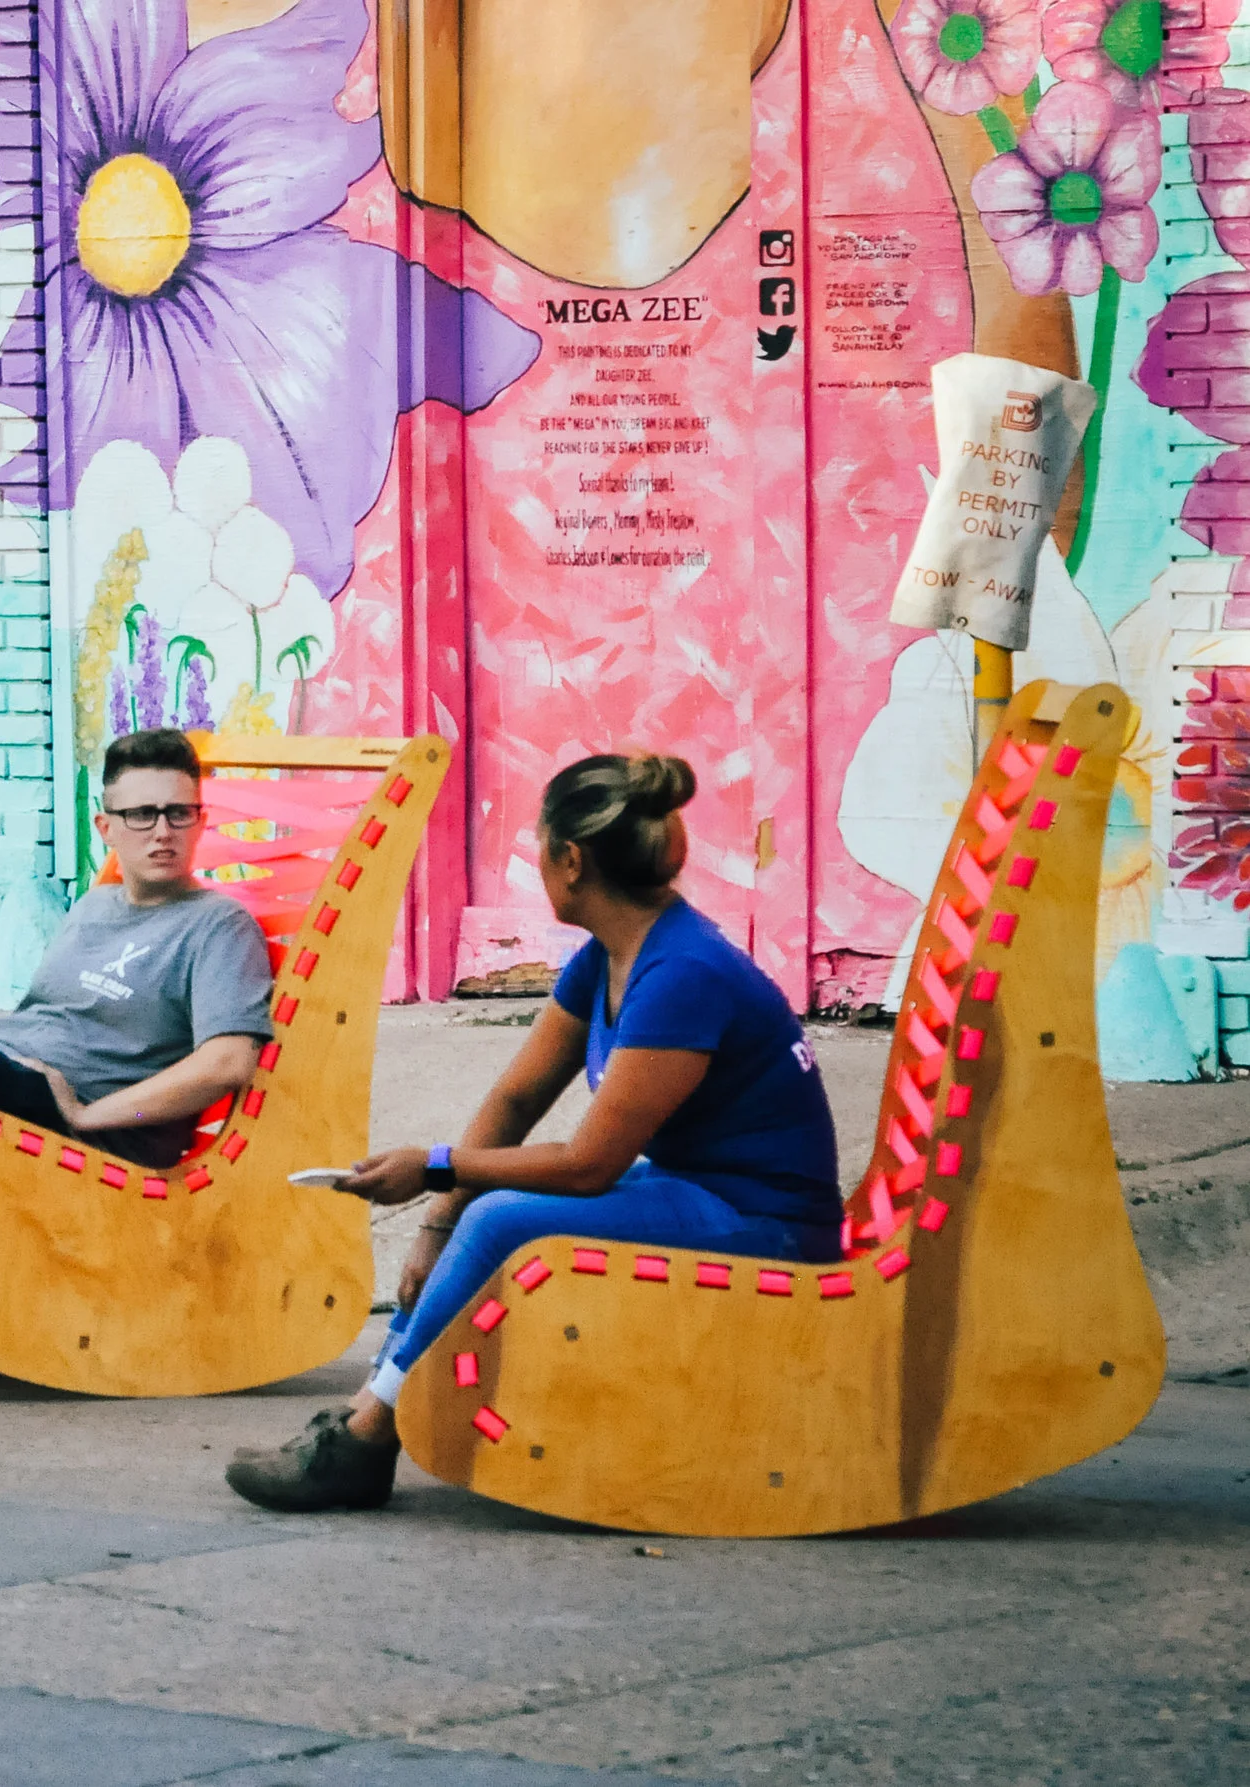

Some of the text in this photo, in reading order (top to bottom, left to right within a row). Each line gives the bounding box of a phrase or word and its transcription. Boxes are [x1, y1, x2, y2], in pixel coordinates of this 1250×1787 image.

[817, 244, 847, 252] YOUR
[871, 282, 886, 290] ME
[892, 282, 908, 290] ON
[829, 290, 888, 298] FACEBOOK
[825, 299, 909, 309] SANAH BROWN
[873, 324, 890, 332] ME
[558, 345, 692, 359] THIS PAINTING IS DEDICATED TO MY
[595, 369, 635, 383] DAUGHTER
[570, 393, 586, 406] AND
[587, 393, 600, 406] ALL
[602, 393, 618, 406] OUR
[620, 393, 646, 406] YOUNG
[540, 416, 549, 431] BE
[551, 416, 566, 430] THE
[601, 416, 609, 430] IN
[630, 416, 656, 430] DREAM
[658, 416, 672, 430] BIG
[674, 416, 688, 430] AND
[691, 416, 711, 431] KEEP
[544, 441, 582, 454] REACHING
[583, 441, 599, 454] FOR
[602, 441, 616, 454] THE
[646, 441, 671, 454] NEVER
[674, 441, 690, 454] GIVE
[692, 441, 709, 454] UP!
[961, 440, 1051, 474] PARKING
[990, 470, 1022, 489] BY
[958, 490, 1043, 520] PERMIT
[962, 516, 1023, 541] ONLY
[913, 567, 960, 588] TOW
[982, 578, 1032, 604] AWA
